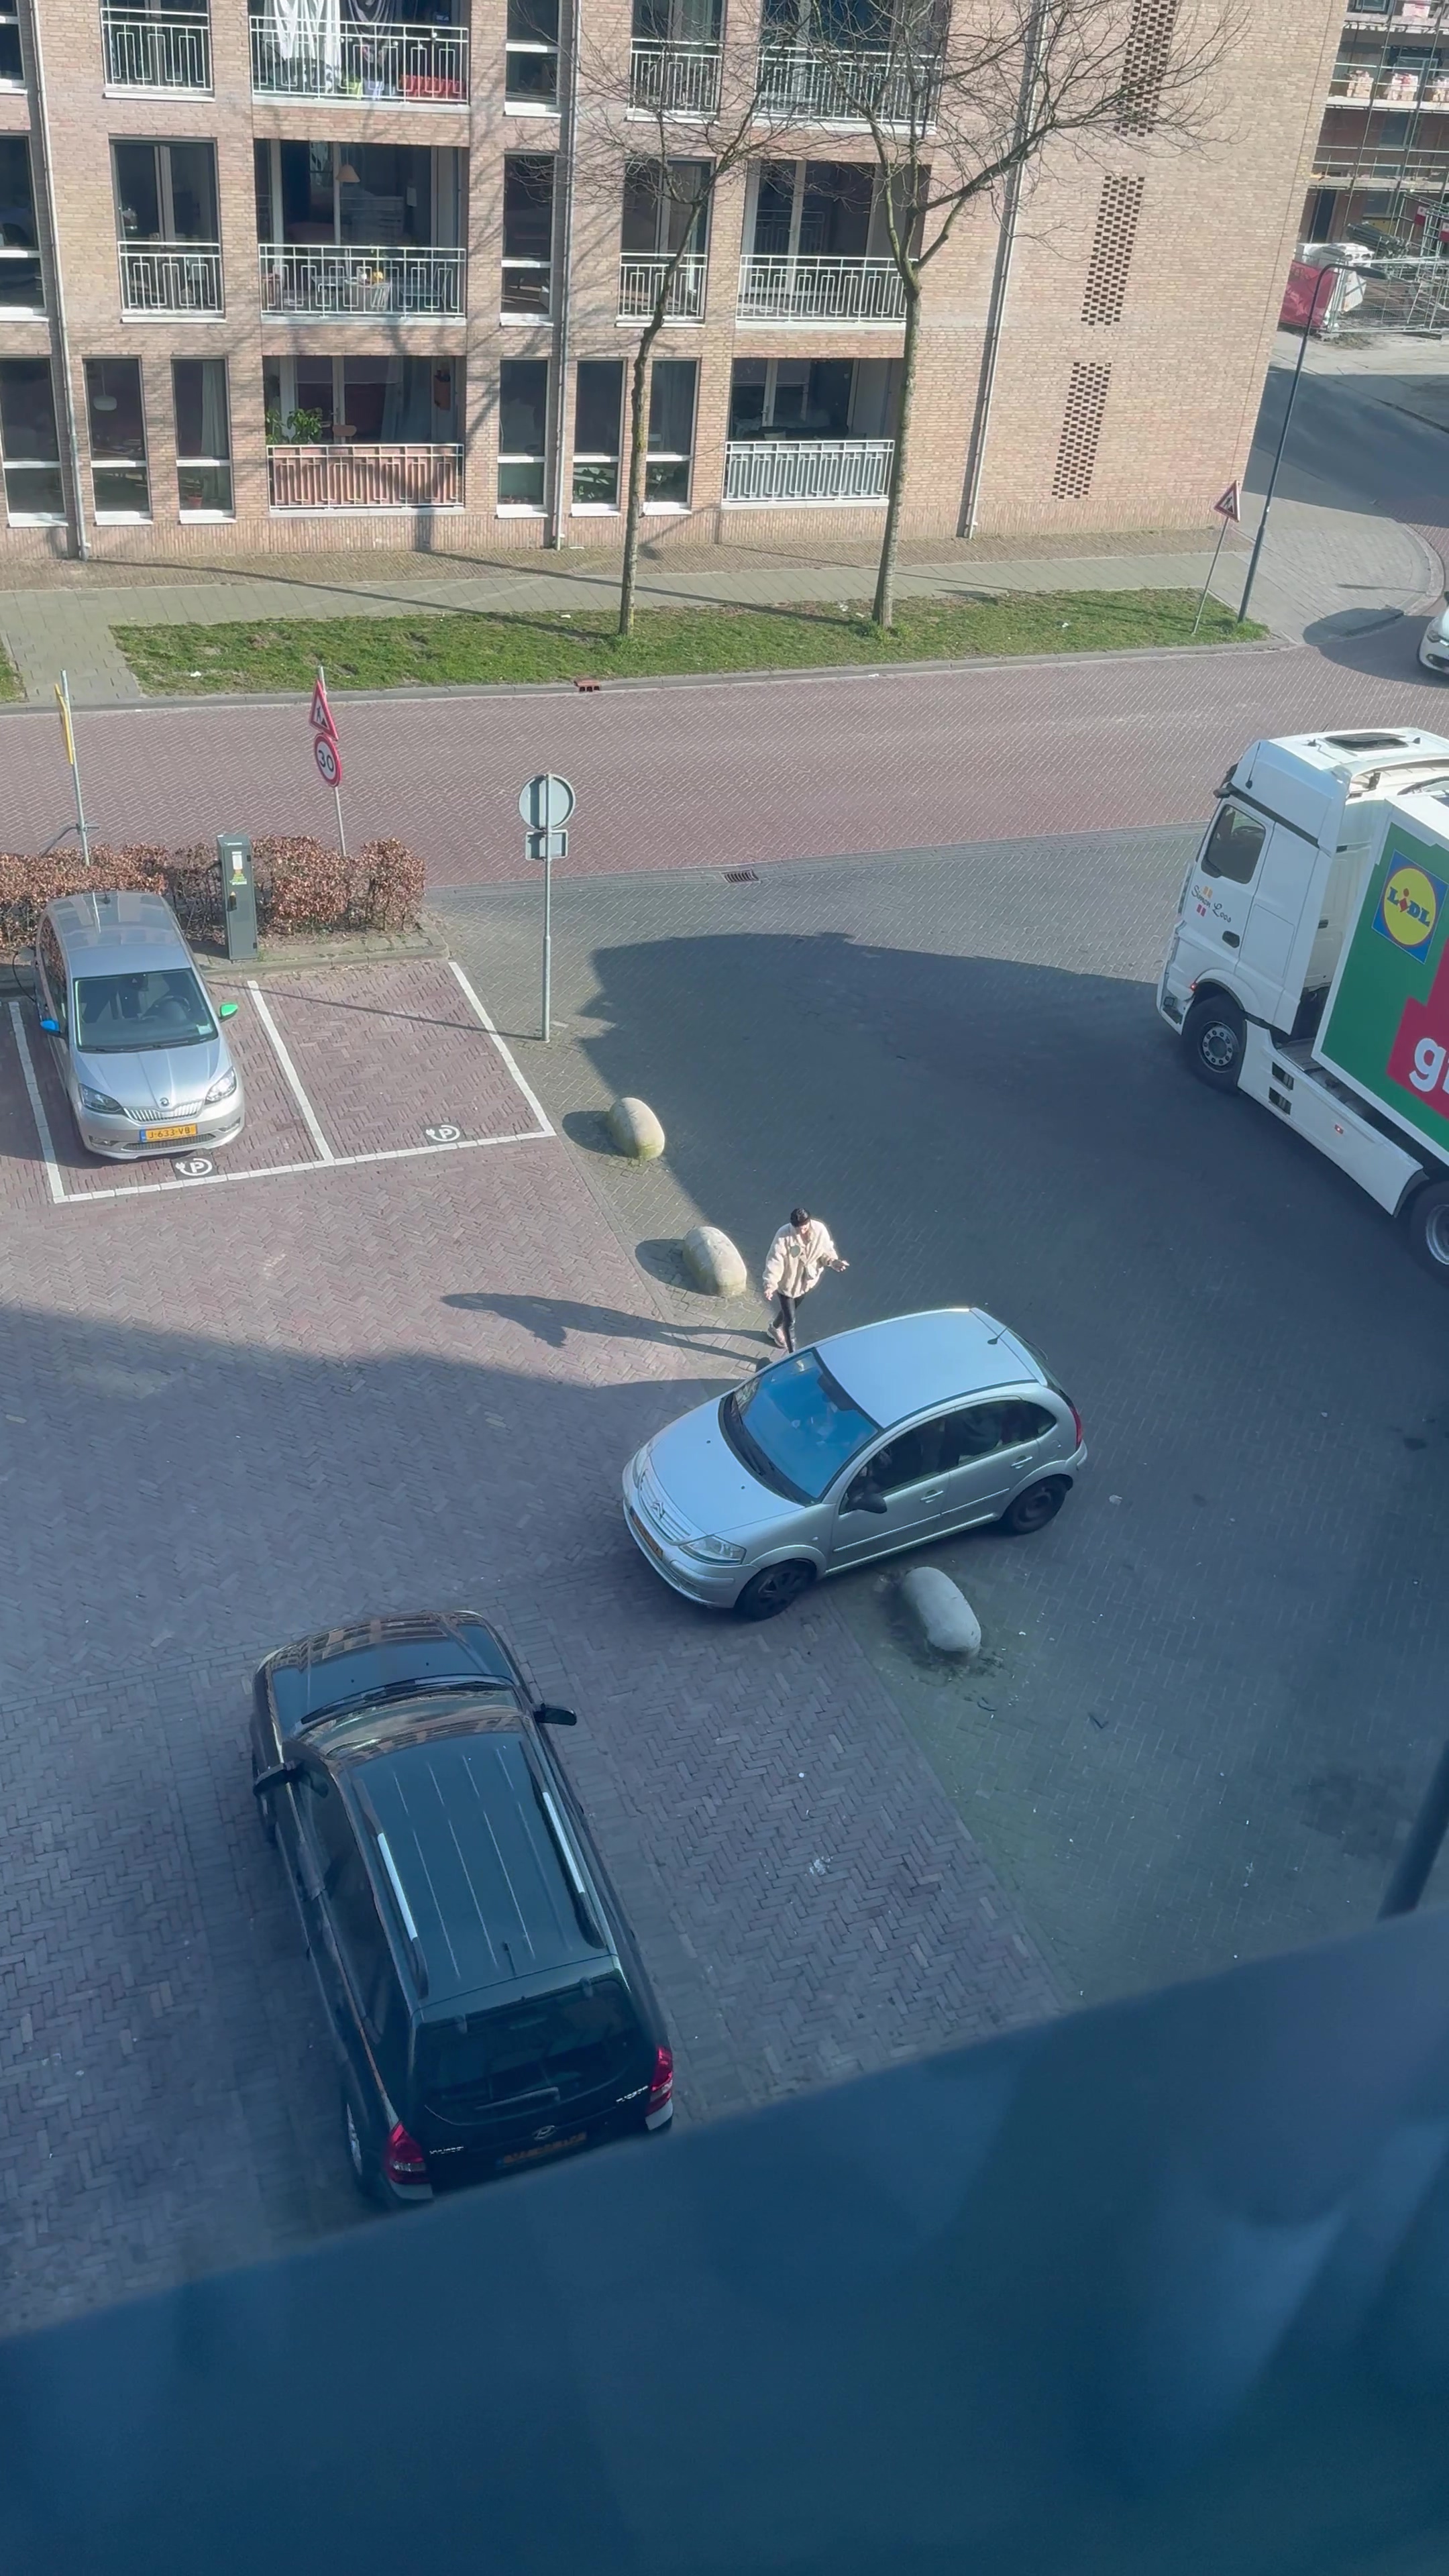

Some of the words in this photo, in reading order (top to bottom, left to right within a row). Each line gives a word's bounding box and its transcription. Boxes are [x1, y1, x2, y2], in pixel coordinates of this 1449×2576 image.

[319, 749, 334, 772] 30
[1212, 903, 1232, 923] Loos
[1409, 1037, 1449, 1094] g
[149, 1127, 191, 1138] J-633-VB
[438, 1128, 453, 1139] P
[190, 1161, 204, 1173] P
